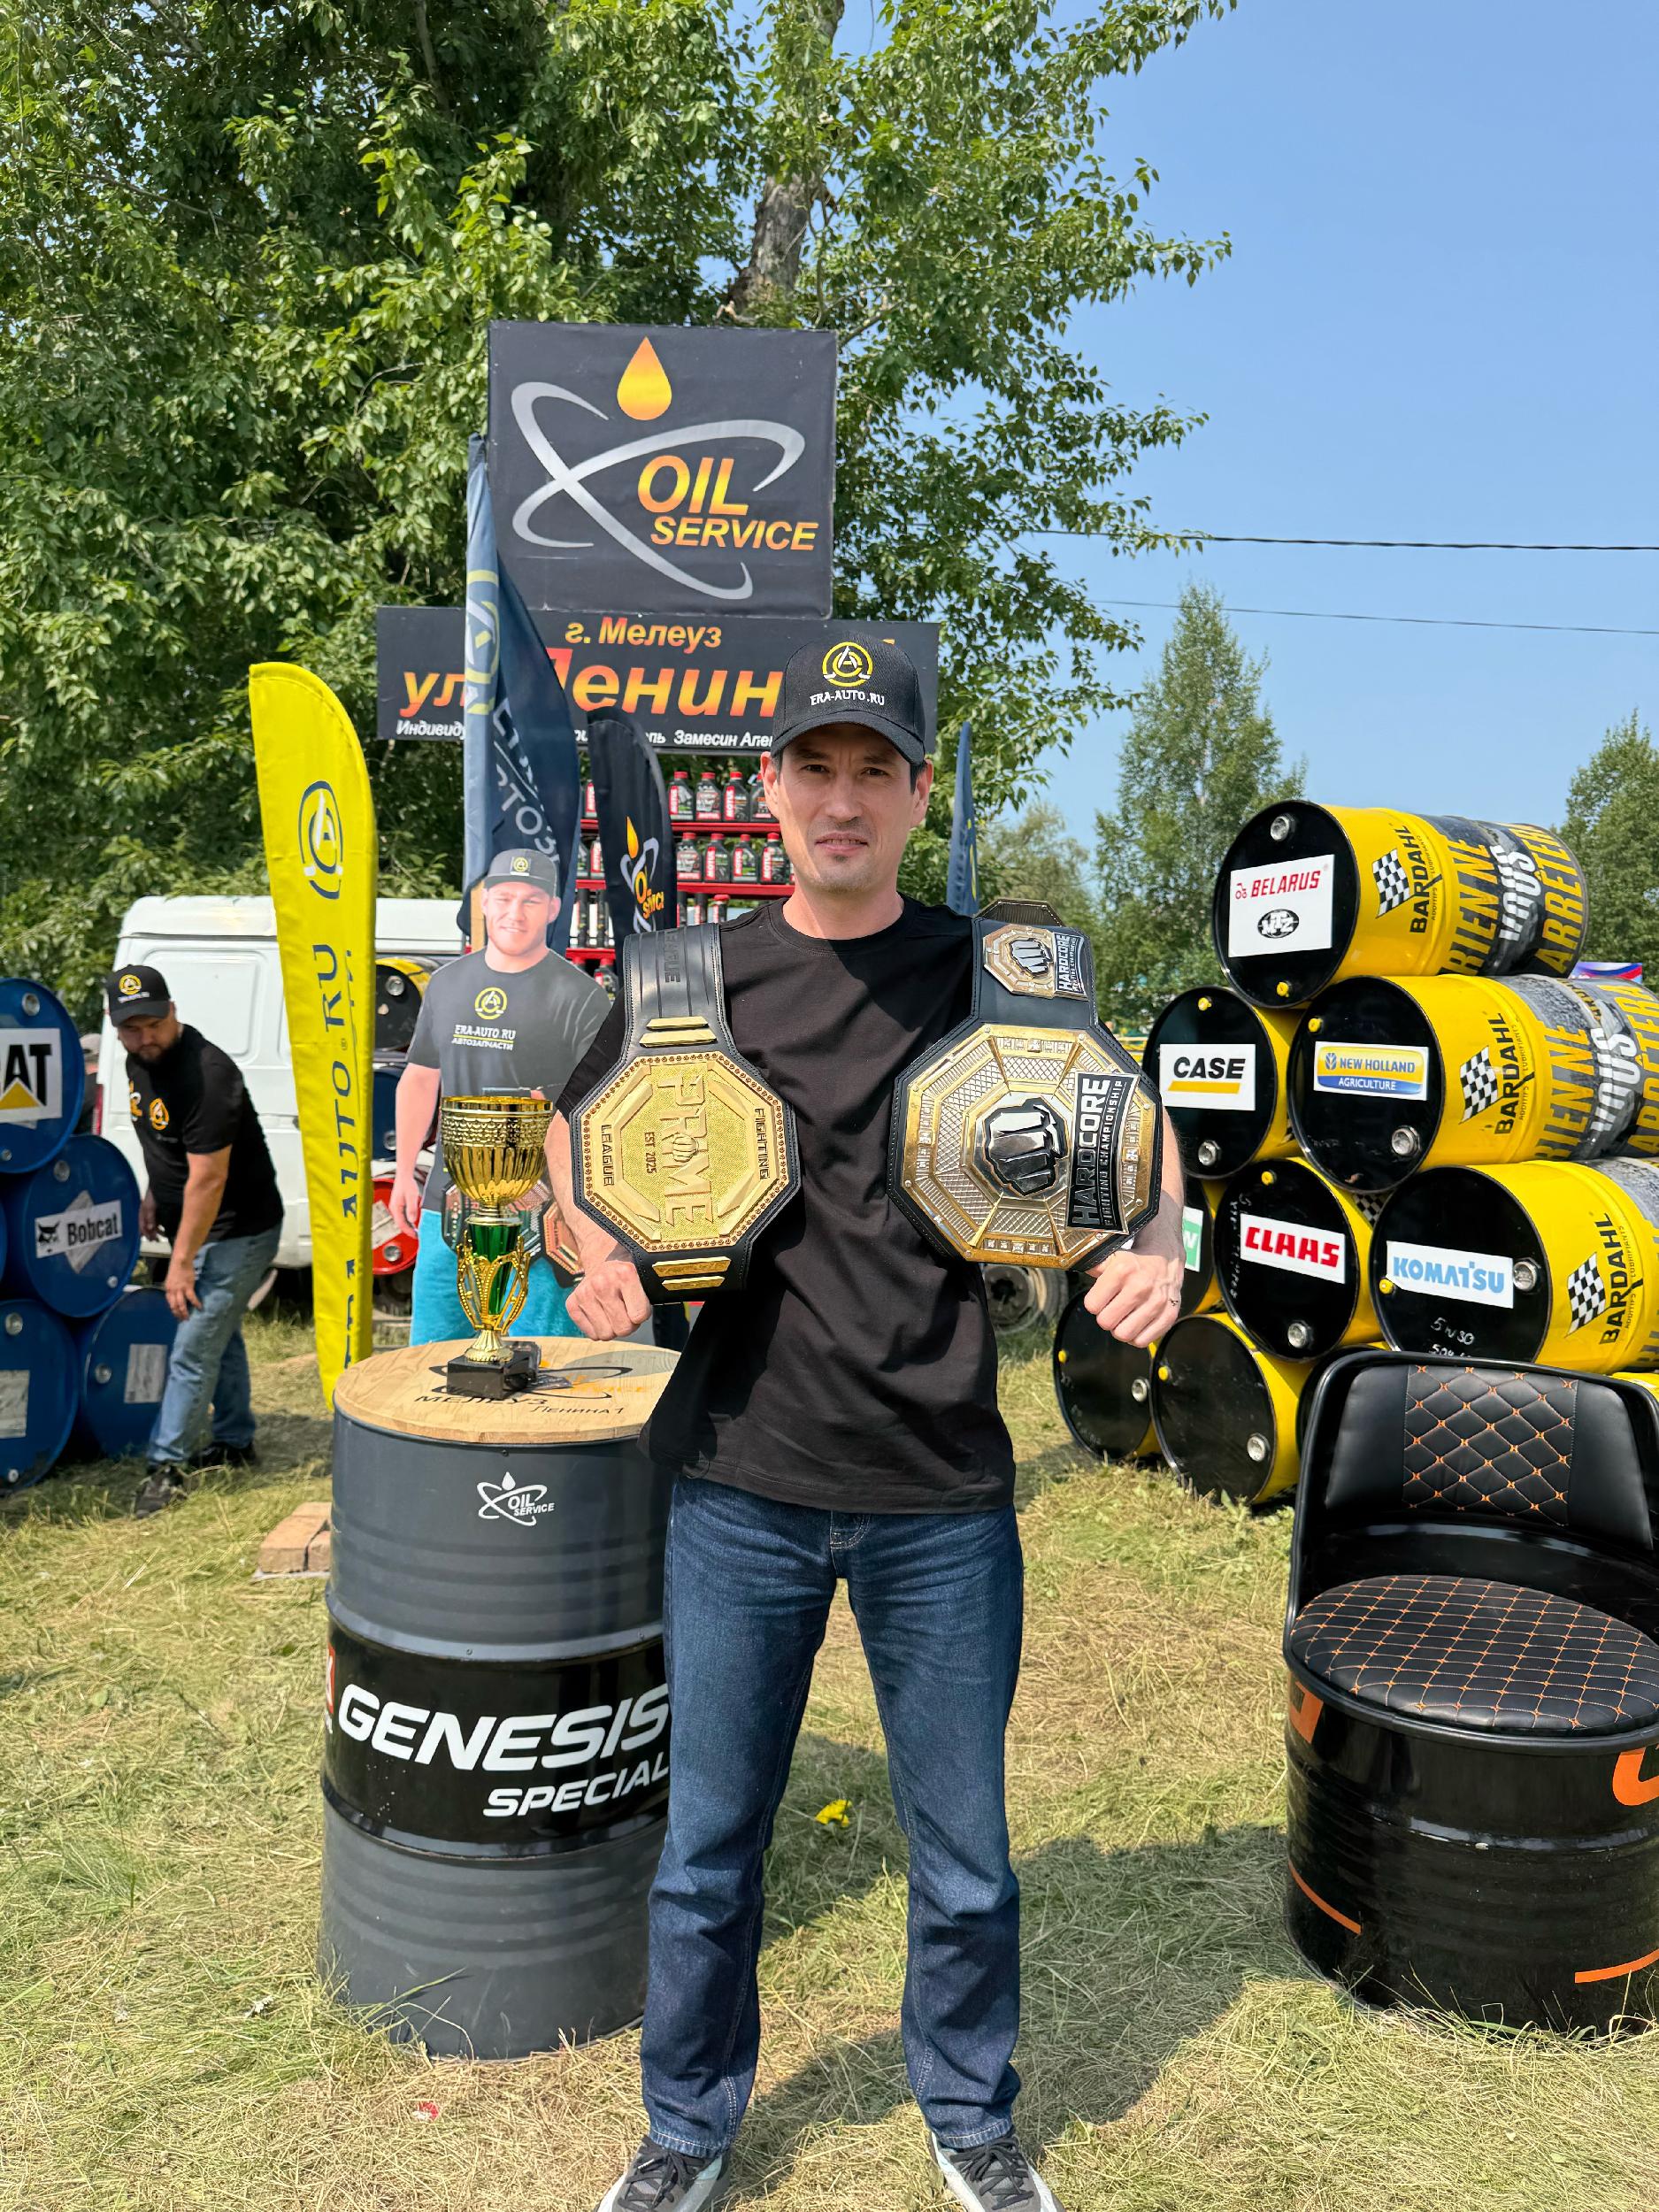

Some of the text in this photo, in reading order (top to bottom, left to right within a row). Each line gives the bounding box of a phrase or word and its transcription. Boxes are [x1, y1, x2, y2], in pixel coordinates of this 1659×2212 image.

[637, 456, 750, 517] OIL
[650, 517, 819, 551] SERVICE
[565, 617, 722, 654] г. Мелеуз
[545, 648, 784, 718] енин
[809, 689, 885, 706] ERA-AUTO.RU
[673, 729, 739, 748] Замесин
[707, 850, 716, 878] MOTUL
[1250, 871, 1321, 898] BELARUS
[1394, 826, 1431, 933] BARDAHL
[1443, 840, 1499, 976] RIEN NE
[1490, 844, 1541, 941] VOUS
[1261, 910, 1294, 935] MTZ
[1056, 933, 1072, 990] HARDCORE
[312, 944, 346, 1033] RU
[451, 1037, 514, 1051] АВТОЗАПЧАСТИ
[454, 1025, 517, 1041] ERA-AUTO.RU
[1543, 1025, 1594, 1077] NE
[0, 1043, 52, 1107] AT
[1173, 1056, 1246, 1079] CASE
[1338, 1078, 1397, 1091] AGRICULTURE
[1340, 1058, 1416, 1073] NEW HOLLAND
[1487, 1013, 1520, 1134] BARDAHL
[1590, 1027, 1641, 1132] VOUS
[644, 1132, 656, 1148] EST
[754, 1108, 770, 1180] FIGHTING
[1102, 1080, 1123, 1166] CHAMPIONSHIP
[601, 1125, 614, 1187] LEAGUE
[657, 1075, 714, 1226] PRIME
[1072, 1078, 1111, 1225] HARDCORE
[66, 1213, 119, 1246] Bobcat
[1245, 1226, 1340, 1268] CLAAS
[1393, 1256, 1504, 1293] KOMATSU
[1594, 1213, 1629, 1344] BARDAHL
[507, 1494, 535, 1510] OIL
[513, 1502, 555, 1517] SERVICE
[338, 1683, 669, 1771] GENESIS
[483, 1750, 670, 1817] SPECIAL
